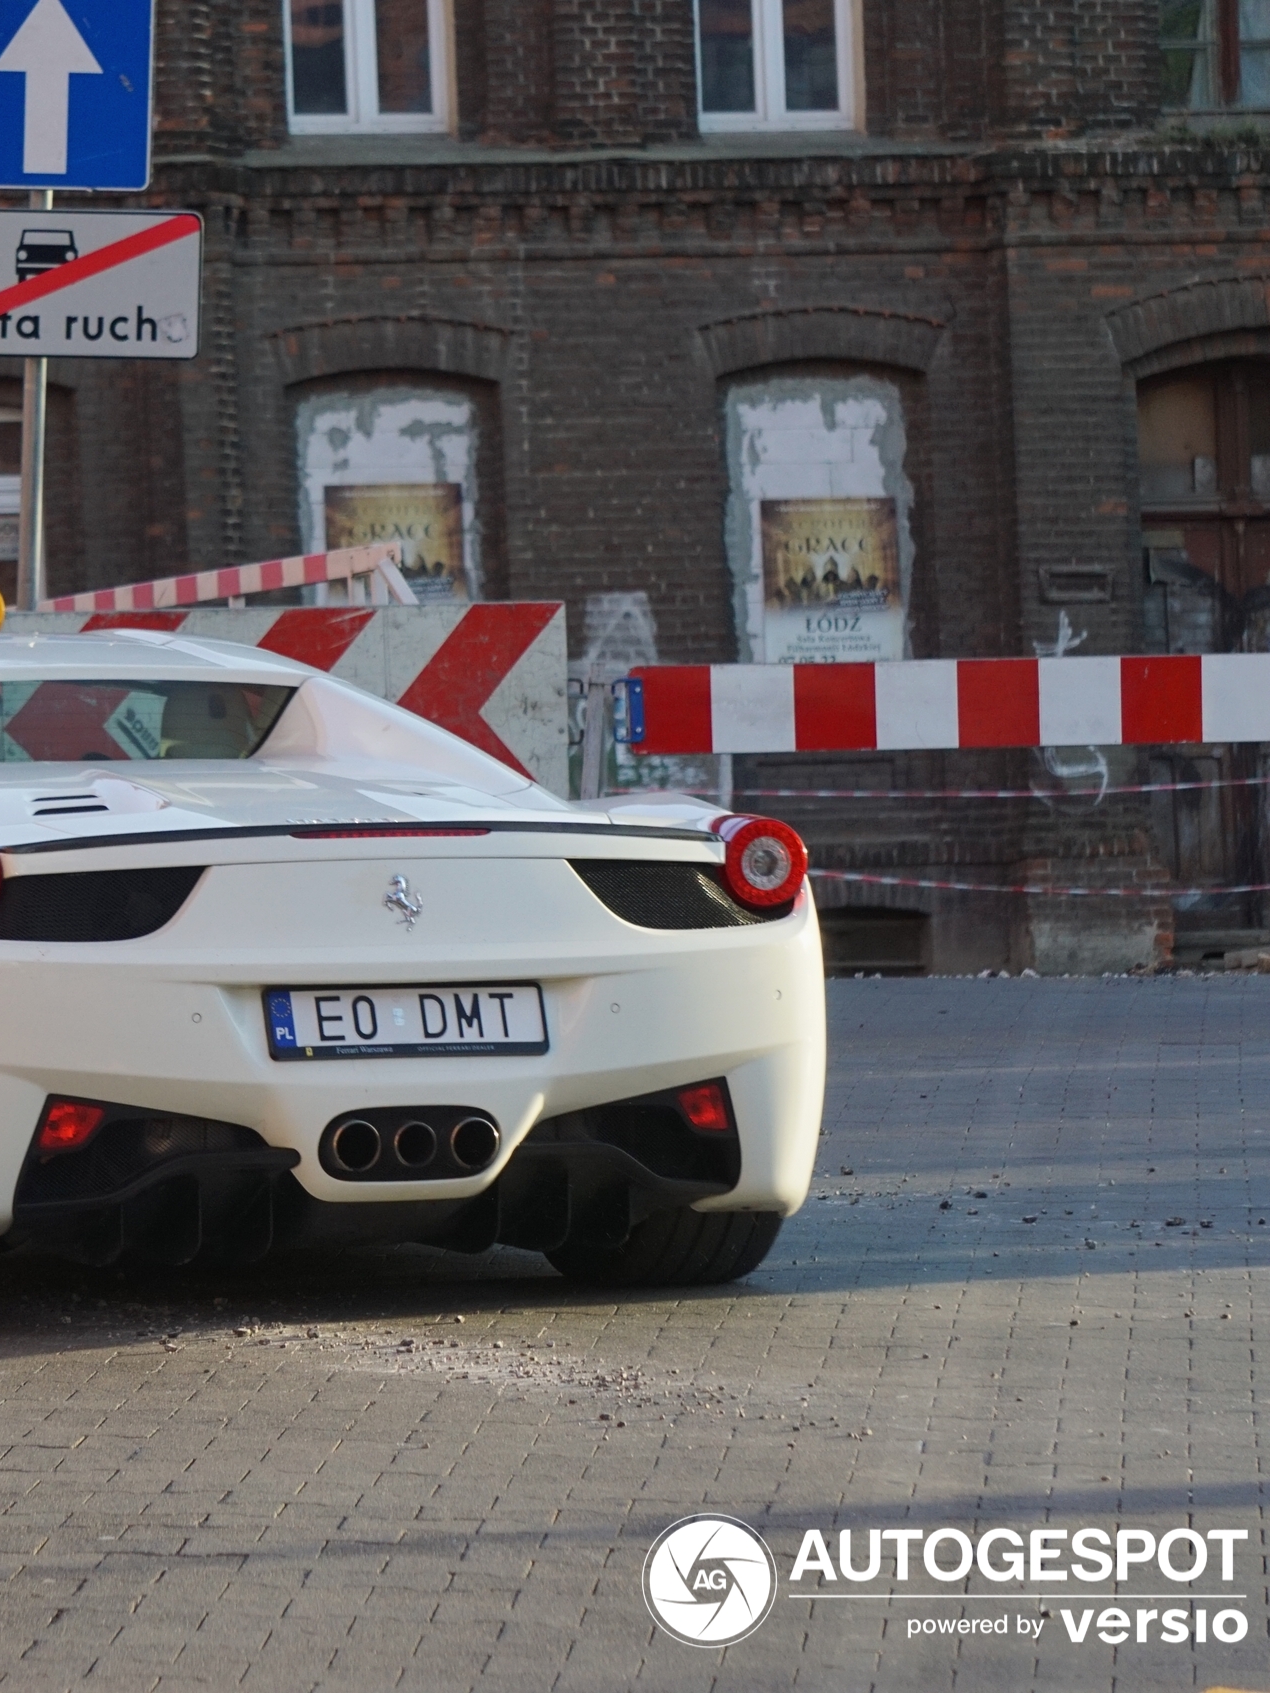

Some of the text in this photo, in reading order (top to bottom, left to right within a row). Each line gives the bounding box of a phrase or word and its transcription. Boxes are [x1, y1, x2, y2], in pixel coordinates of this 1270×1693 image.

[65, 304, 188, 343] ruch
[806, 612, 862, 633] ŁÓDŹ
[418, 993, 514, 1039] DMT
[276, 1027, 294, 1040] PL
